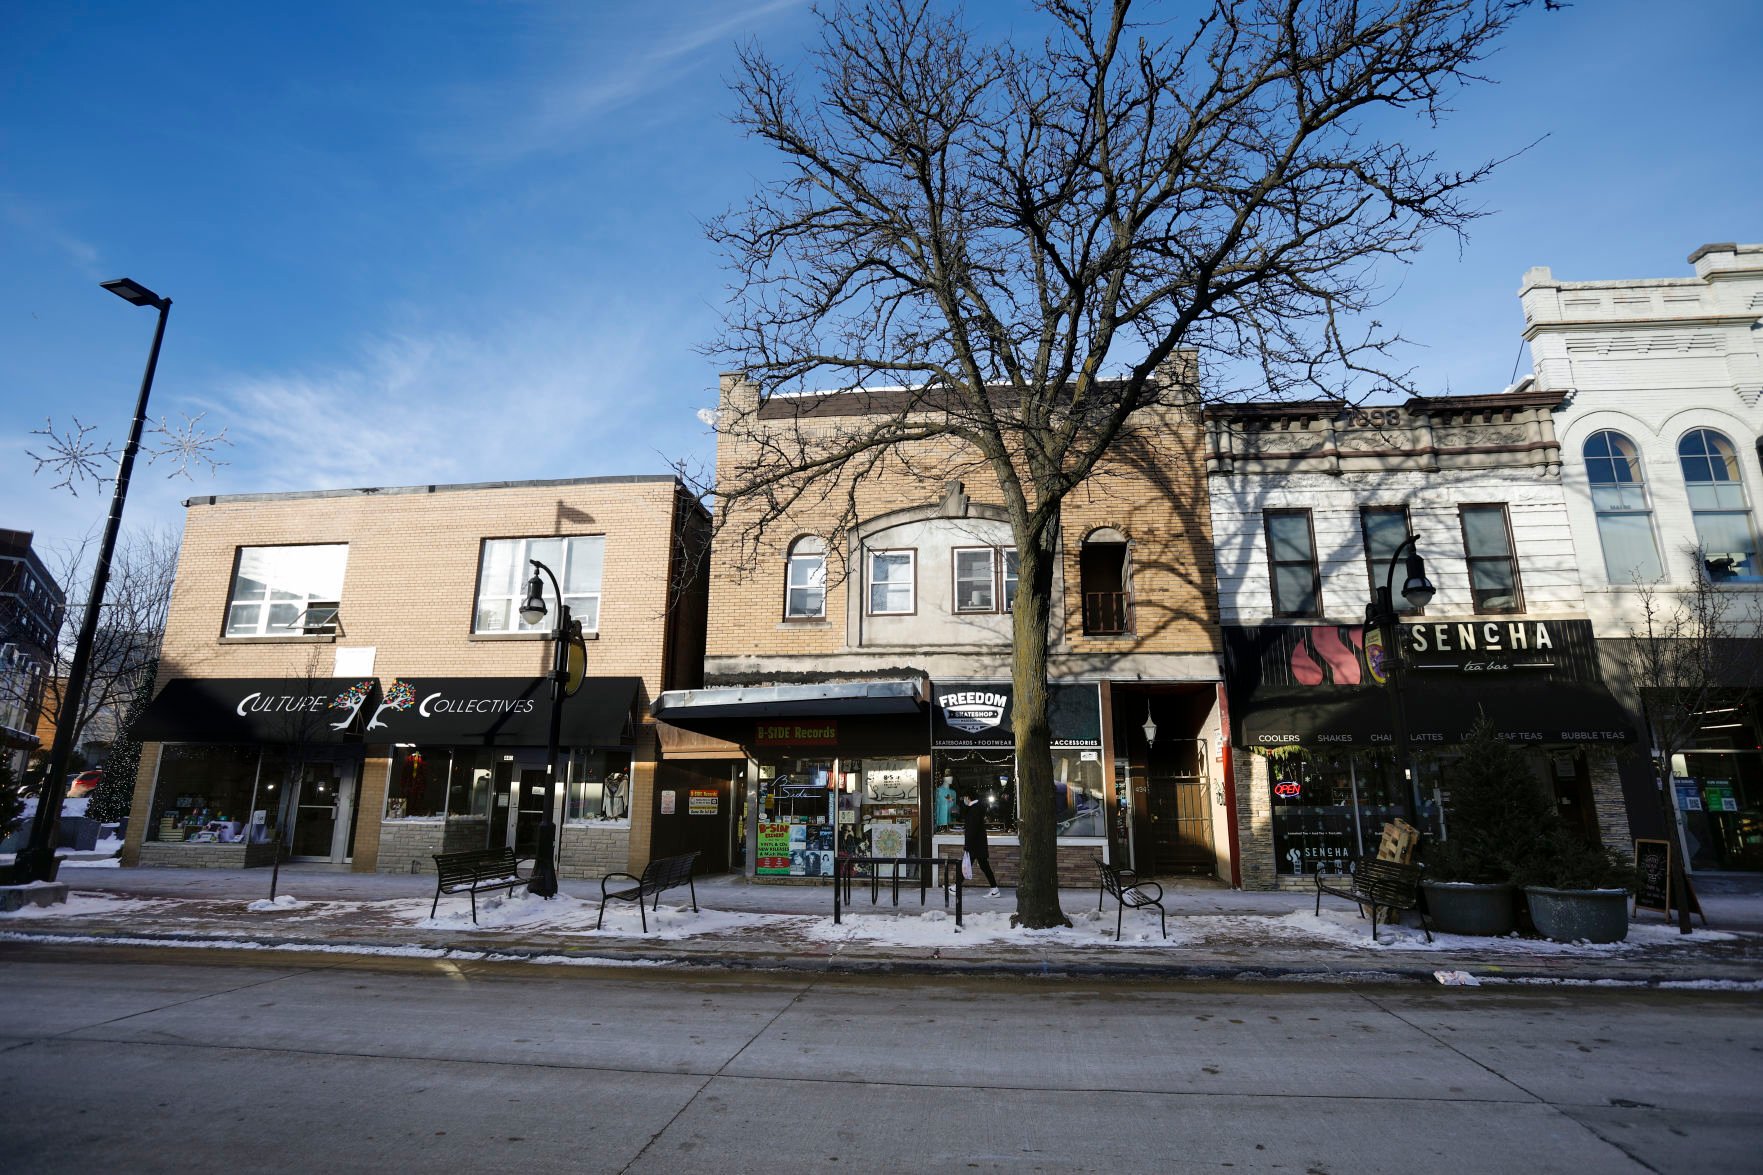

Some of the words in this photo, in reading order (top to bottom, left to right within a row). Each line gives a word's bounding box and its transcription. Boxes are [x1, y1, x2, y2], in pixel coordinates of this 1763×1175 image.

[1411, 622, 1552, 651] SENCHA
[1464, 661, 1484, 671] tea
[1487, 661, 1509, 670] bar
[237, 692, 327, 717] CULTURE
[419, 692, 534, 717] COLLECTIVES
[939, 692, 1007, 708] FREEDOM
[758, 727, 790, 739] B-SIDE
[795, 726, 836, 739] Records
[1370, 734, 1392, 742] CHAI
[1410, 733, 1444, 741] LATTES
[1520, 732, 1543, 740] TEAS
[1561, 731, 1598, 740] BUBBLE
[1600, 731, 1625, 740] TEAS
[1258, 734, 1300, 742] COOLERS
[1317, 734, 1353, 742] SHAKES
[1274, 782, 1301, 795] OPEN
[1305, 847, 1349, 857] SENCHA
